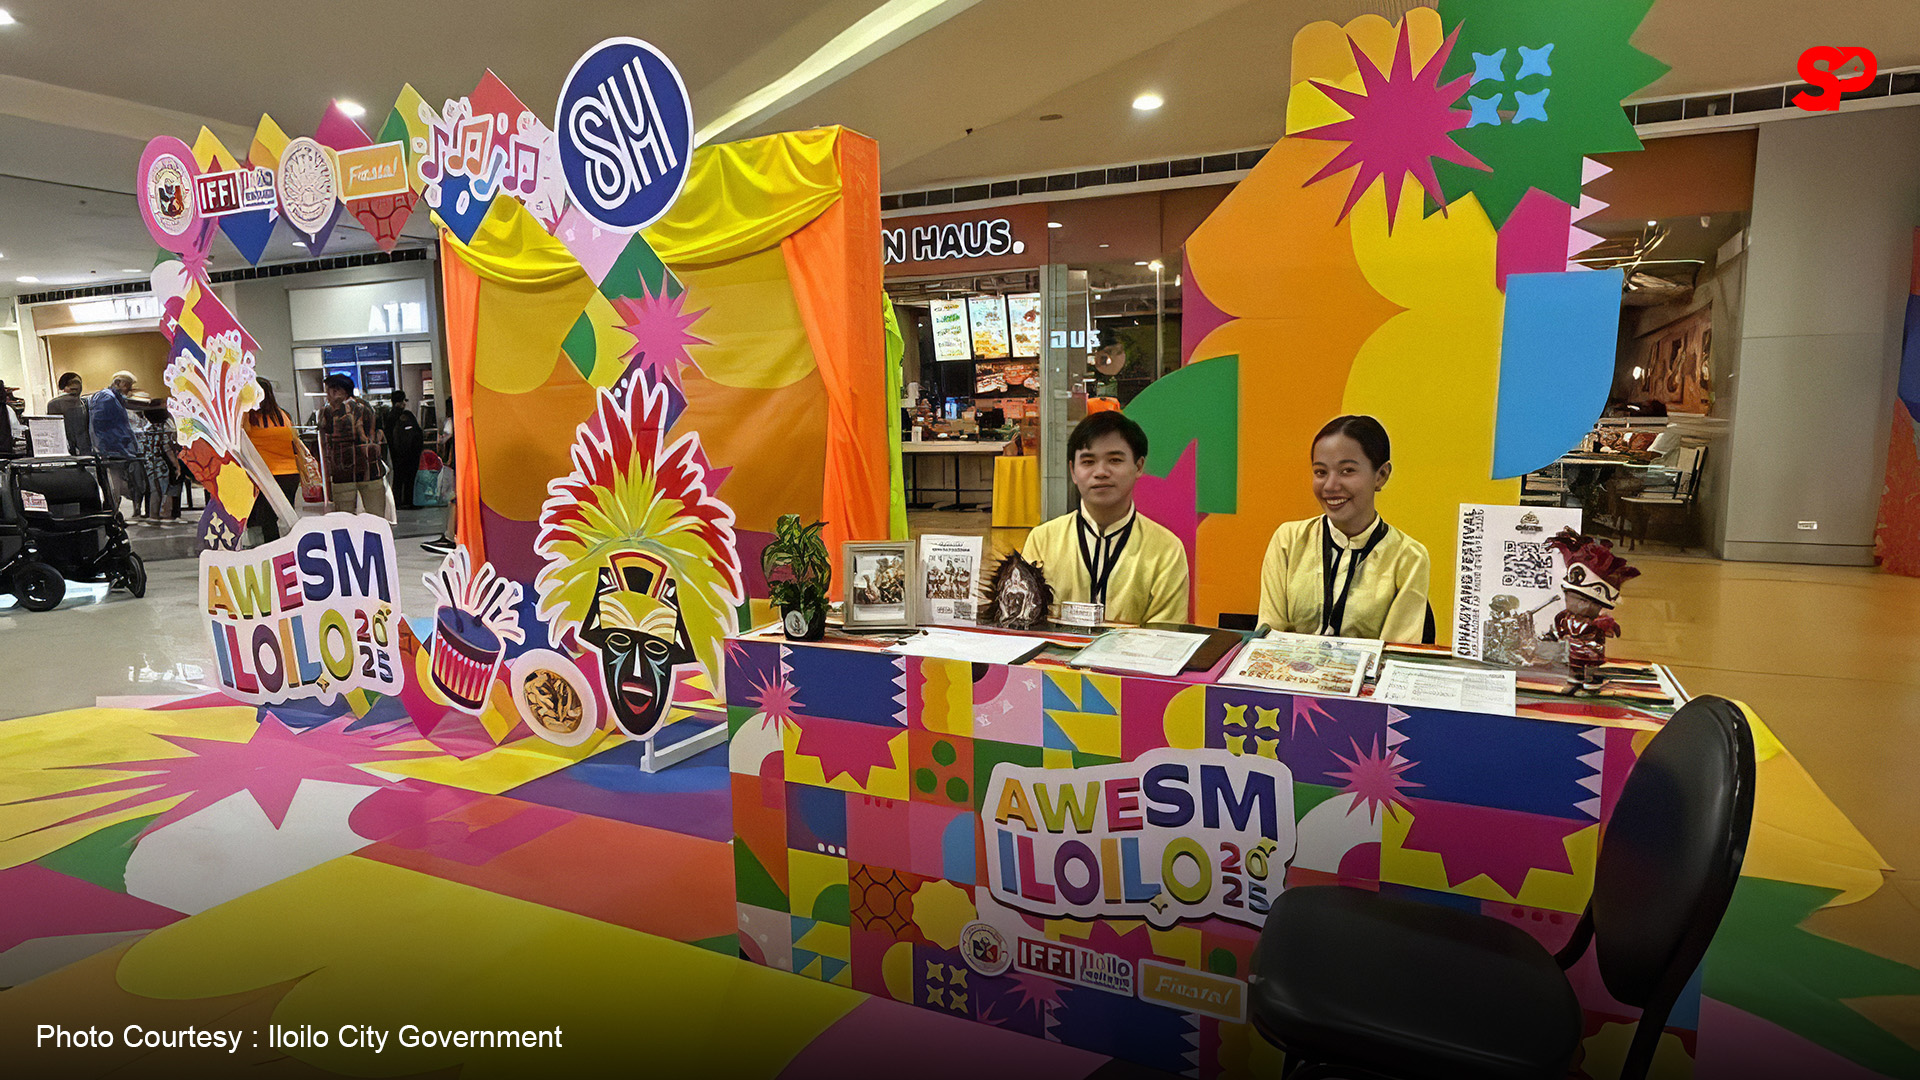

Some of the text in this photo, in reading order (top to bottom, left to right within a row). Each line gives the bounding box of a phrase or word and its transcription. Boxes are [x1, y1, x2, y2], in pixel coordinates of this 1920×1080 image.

[568, 56, 678, 210] SM
[200, 177, 236, 210] IFFI
[911, 219, 1025, 261] HAUS.
[208, 528, 391, 620] AWESM
[211, 608, 355, 694] ILOILO
[359, 645, 394, 684] 25
[995, 763, 1279, 842] AWESM
[997, 828, 1213, 906] ILOILO
[1222, 875, 1271, 915] 25
[1021, 941, 1071, 974] IFFI
